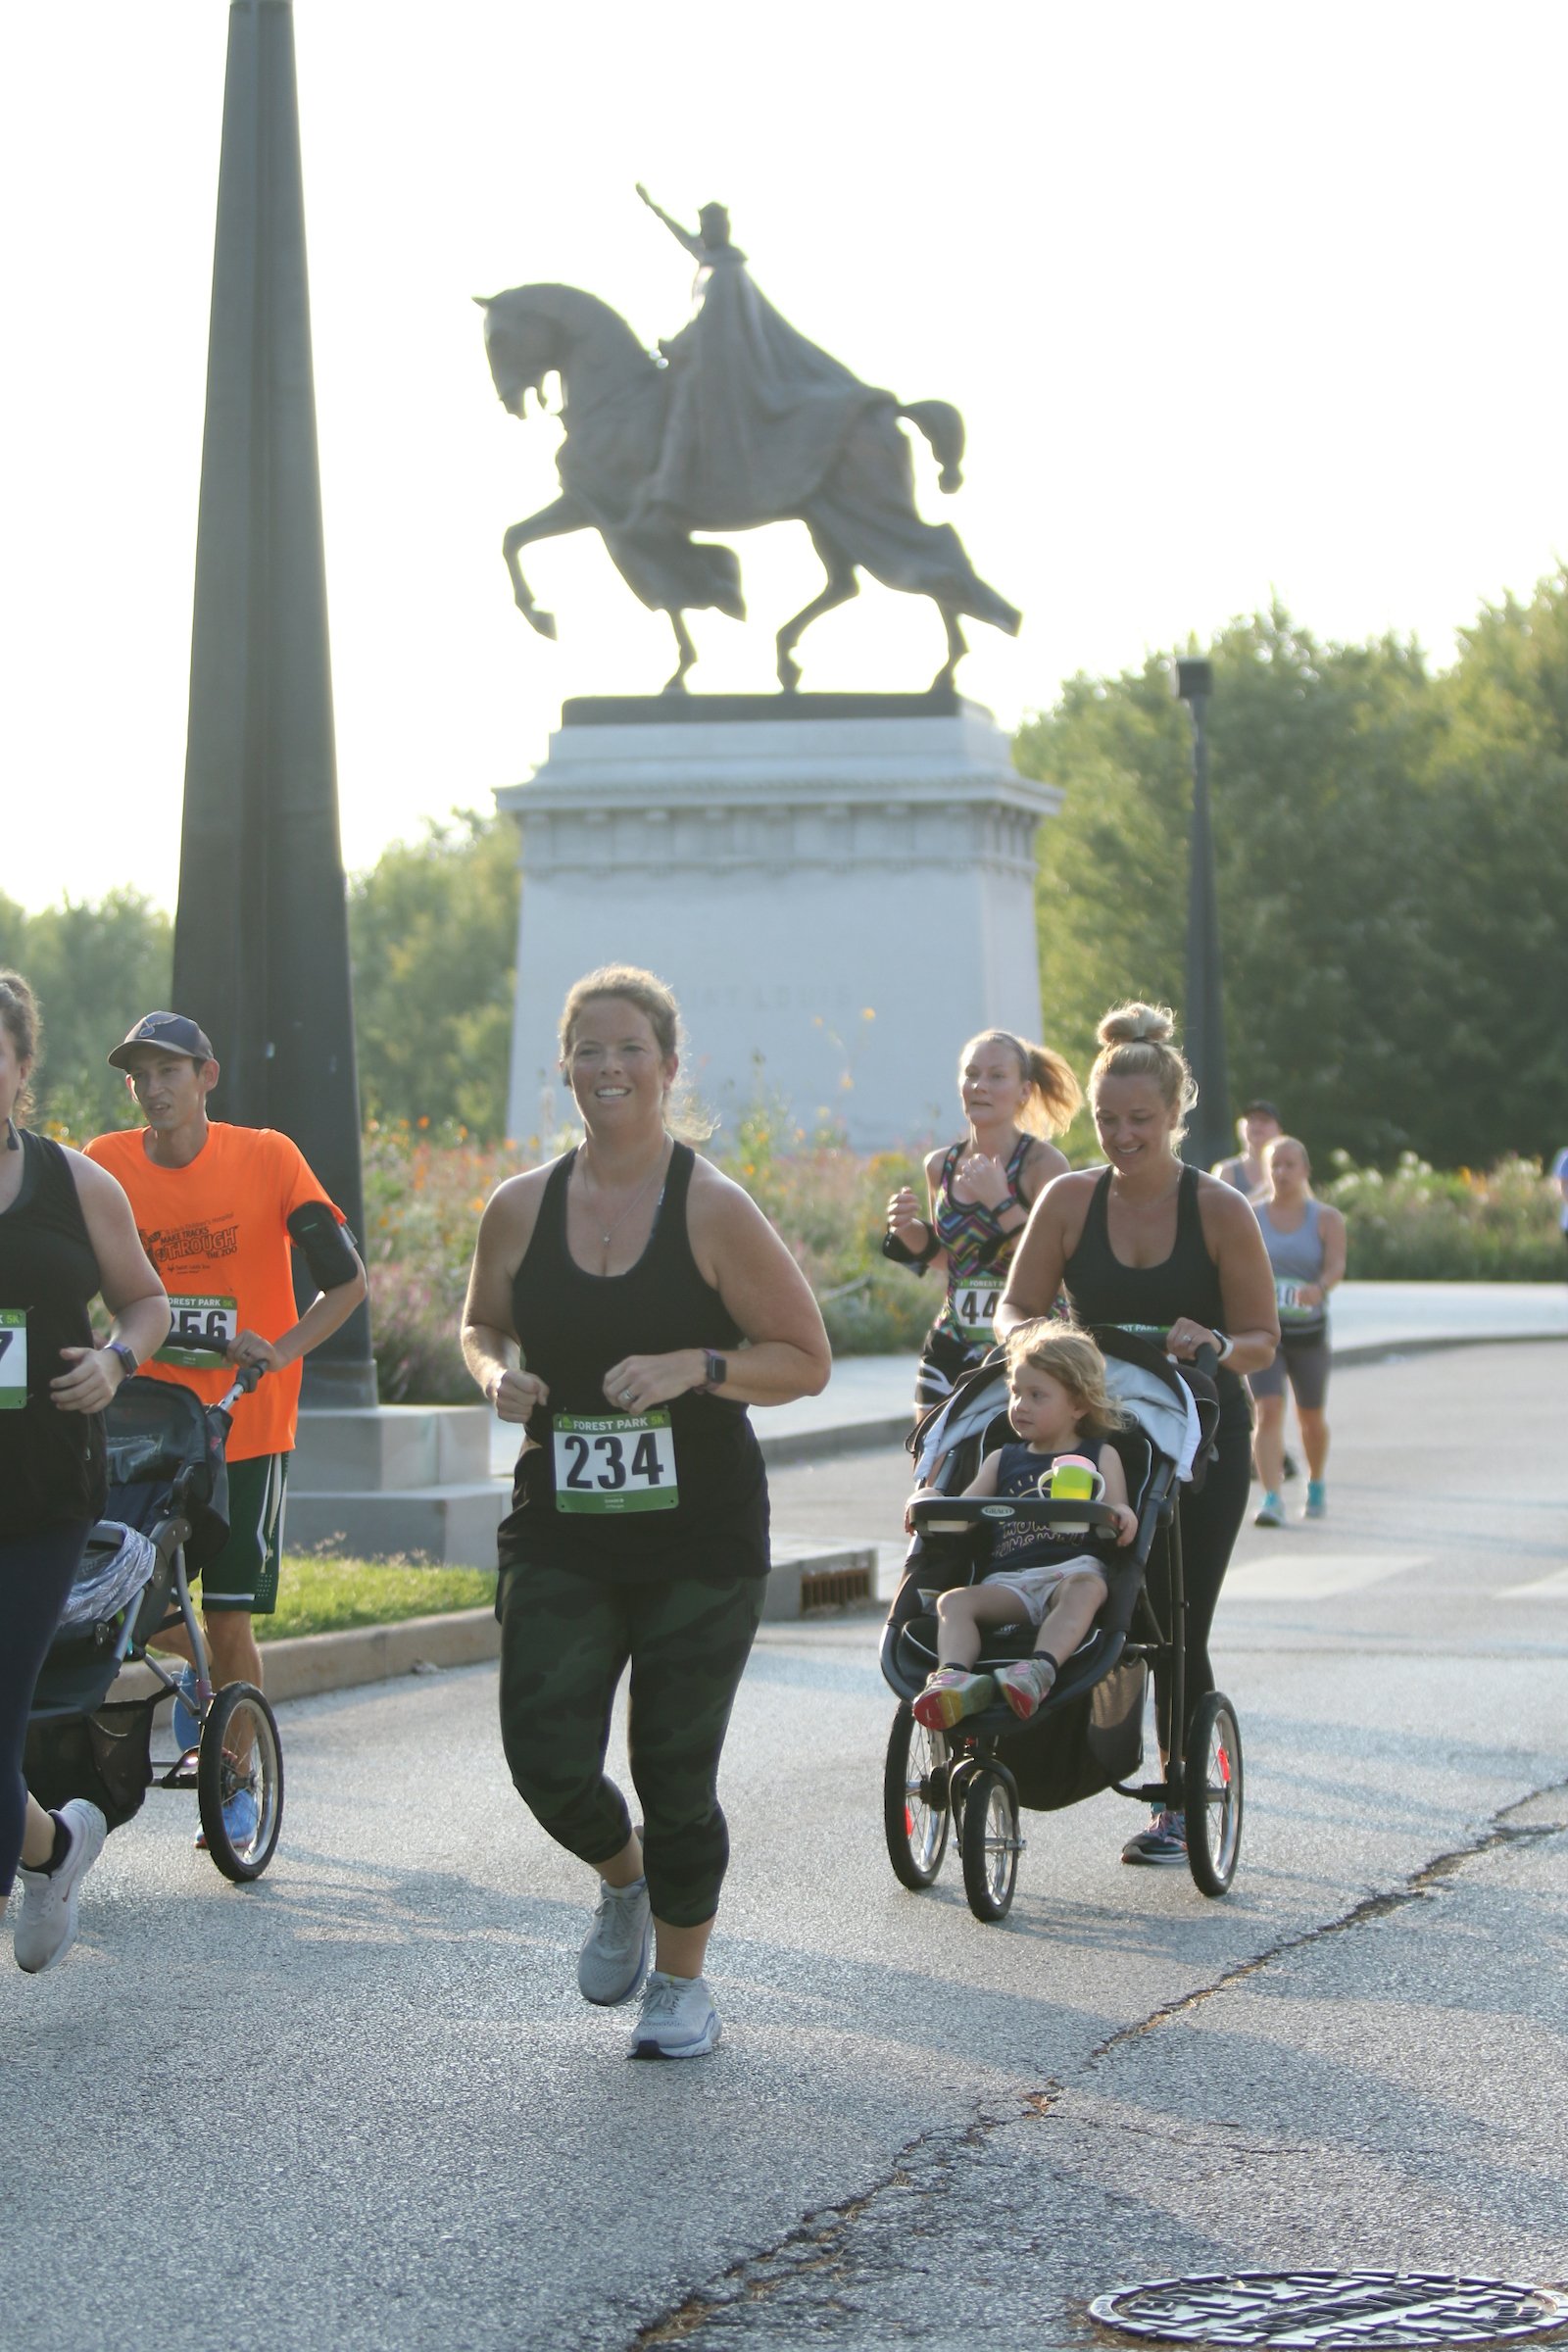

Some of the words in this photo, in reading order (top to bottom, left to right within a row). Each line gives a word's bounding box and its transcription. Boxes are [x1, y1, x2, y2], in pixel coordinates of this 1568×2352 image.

[164, 1227, 236, 1260] THROUGH
[221, 1245, 237, 1257] ZOO
[6, 1314, 20, 1324] 5K
[171, 1309, 227, 1349] 56
[573, 1420, 612, 1431] FOREST
[616, 1417, 648, 1429] PARK
[651, 1415, 664, 1426] 5K
[564, 1432, 663, 1490] 234
